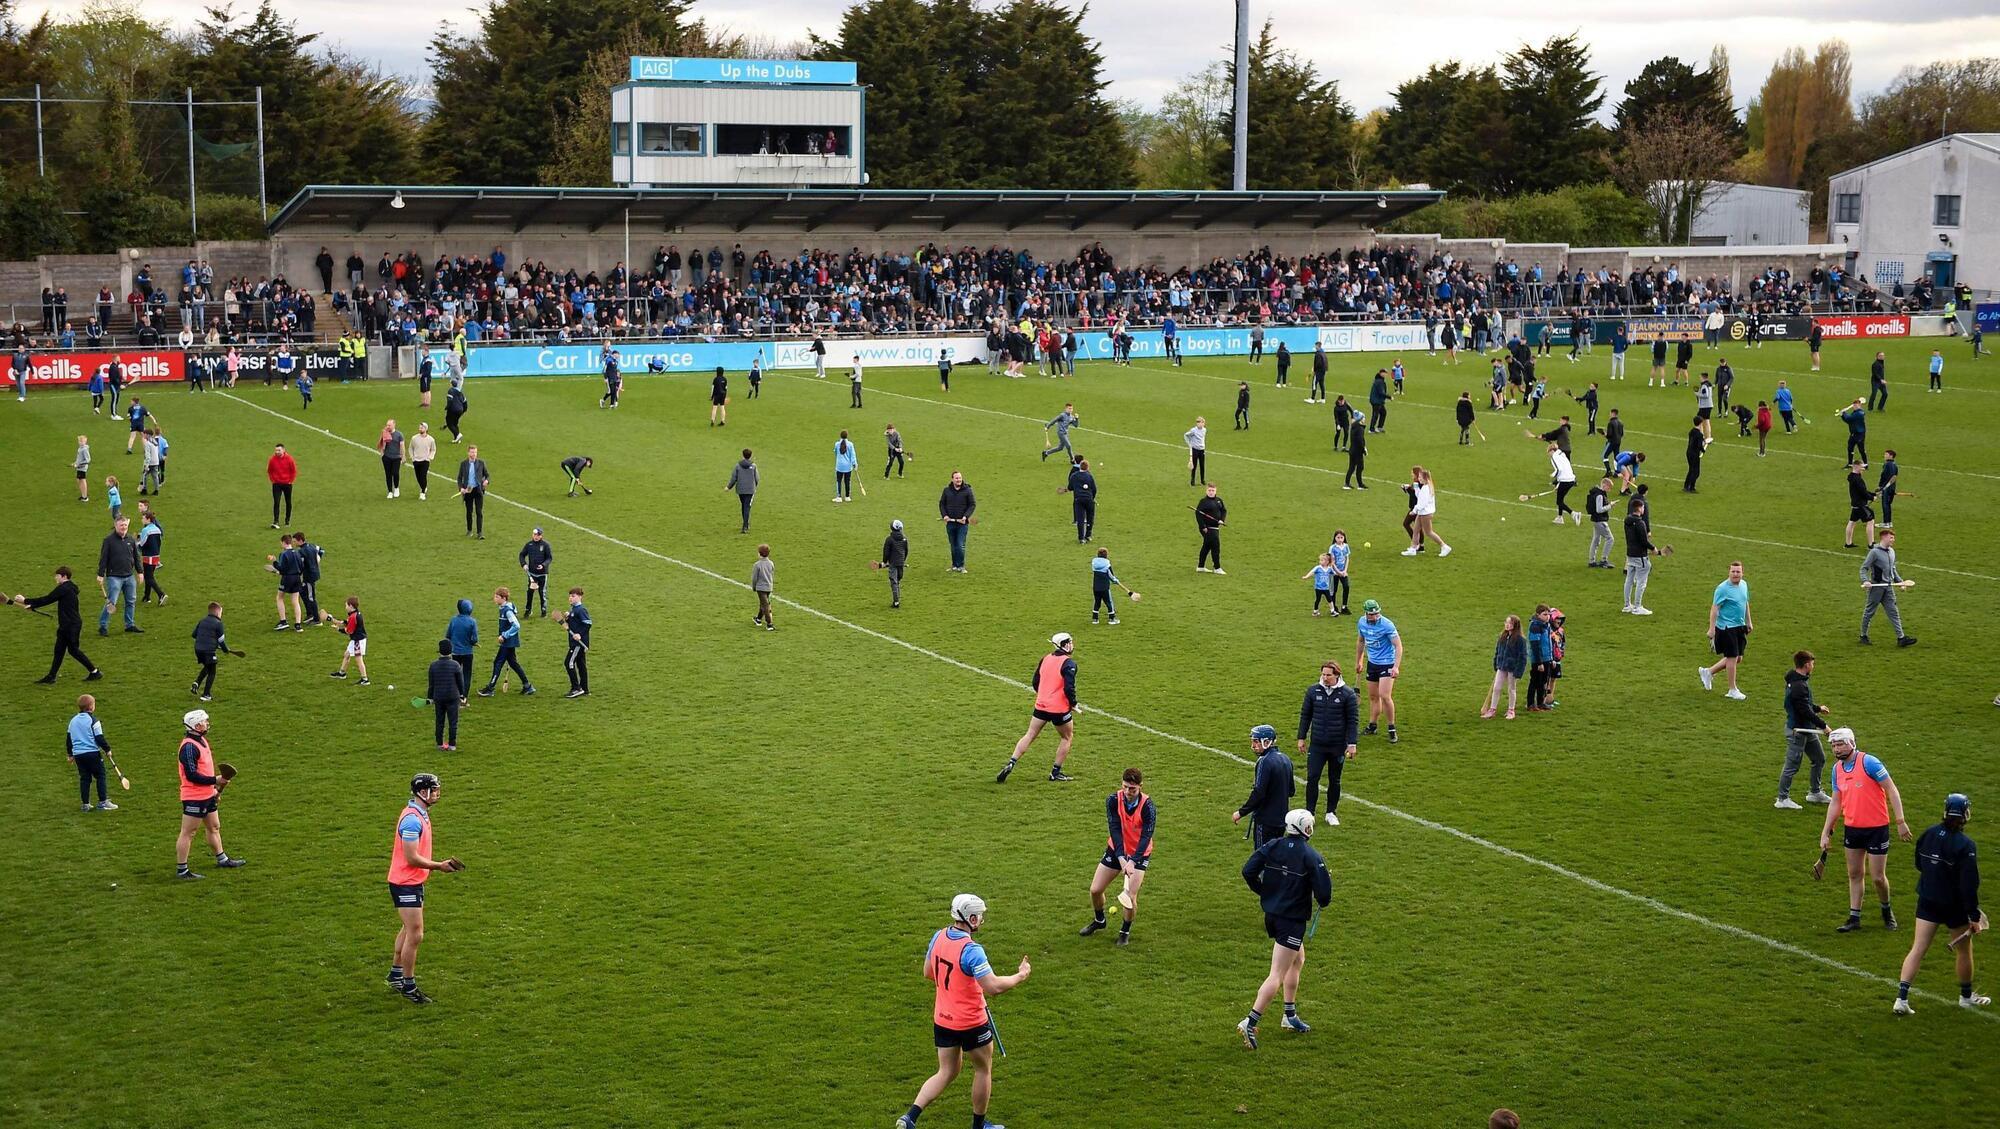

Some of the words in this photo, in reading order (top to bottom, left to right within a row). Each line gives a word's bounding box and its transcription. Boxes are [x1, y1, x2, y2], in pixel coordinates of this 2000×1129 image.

[644, 62, 668, 75] AIG
[721, 63, 741, 80] Up
[746, 64, 769, 78] the
[774, 64, 811, 79] Dubs
[1978, 311, 1988, 320] Go
[1629, 322, 1673, 332] BEAUMONT
[1677, 321, 1703, 331] HOUSE
[1188, 336, 1221, 353] boys
[1228, 334, 1240, 348] in
[1247, 334, 1278, 348] bue
[1324, 332, 1348, 345] AIG
[1374, 330, 1413, 345] Travel
[538, 350, 578, 370] Car
[855, 342, 955, 363] www.aig.e
[935, 955, 954, 991] 17
